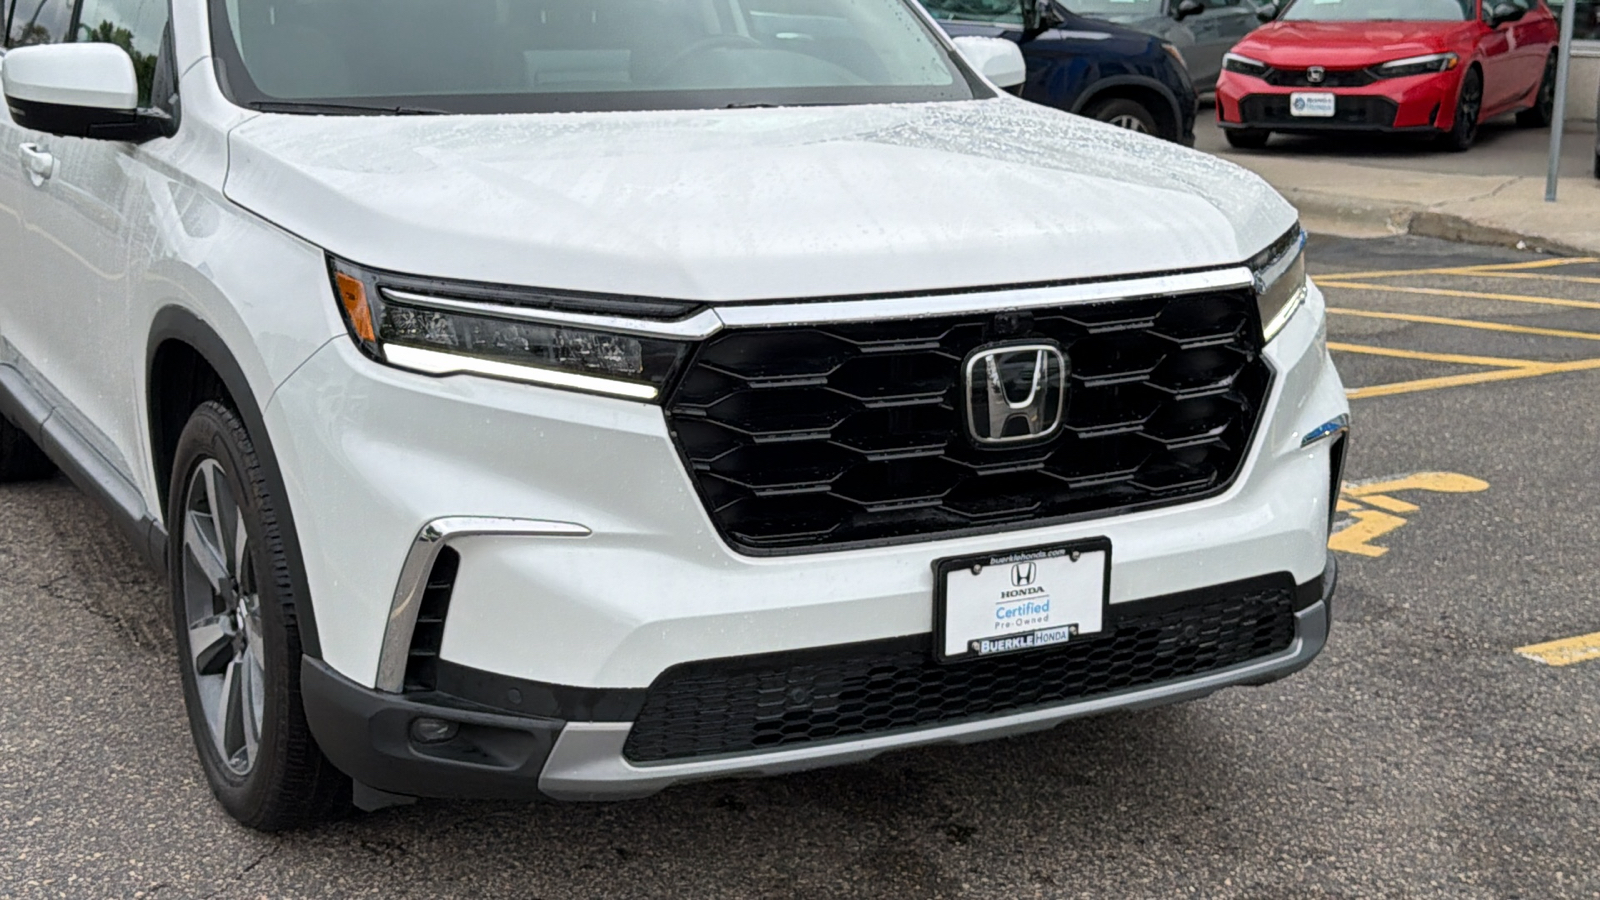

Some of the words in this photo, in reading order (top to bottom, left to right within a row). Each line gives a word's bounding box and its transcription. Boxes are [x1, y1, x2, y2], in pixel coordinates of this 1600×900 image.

[1001, 586, 1045, 599] HONDA
[996, 600, 1050, 620] Certified
[995, 613, 1050, 630] Pre-Owned
[981, 635, 1034, 654] BUERKLE
[1035, 631, 1067, 644] HONDA
